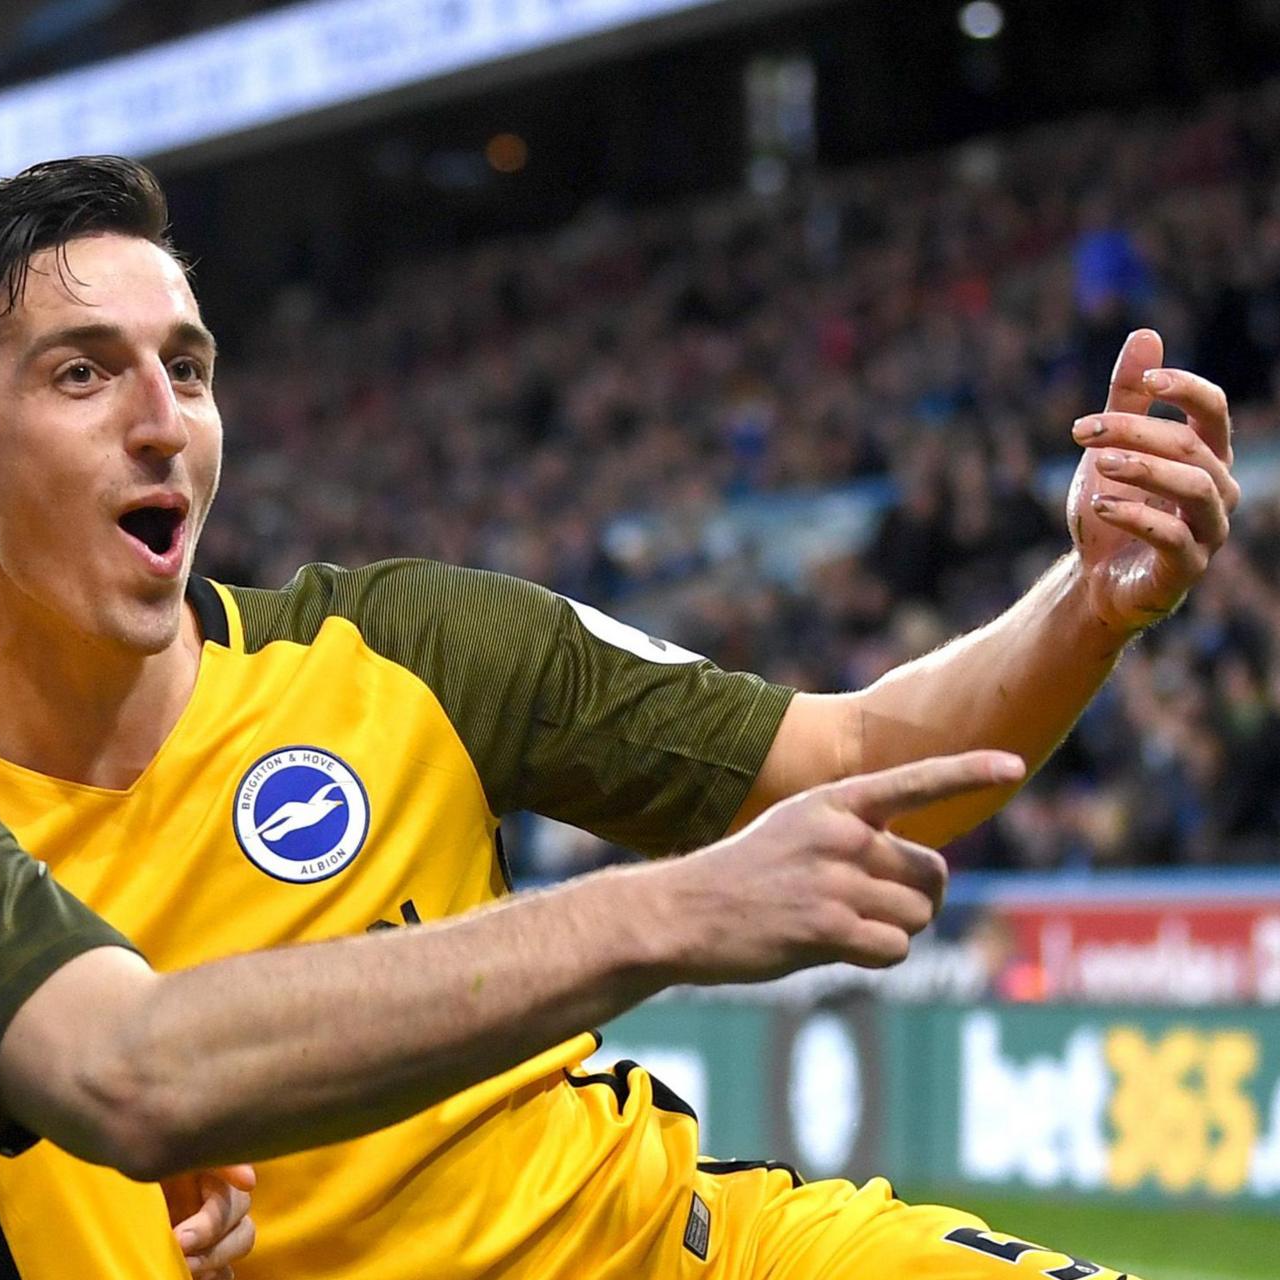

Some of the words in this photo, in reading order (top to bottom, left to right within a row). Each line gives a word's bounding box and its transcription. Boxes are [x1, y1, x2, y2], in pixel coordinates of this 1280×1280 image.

[241, 755, 282, 810] BRIGHTON
[288, 753, 297, 762] &
[303, 753, 335, 772] HOVE
[300, 847, 347, 875] ALBION
